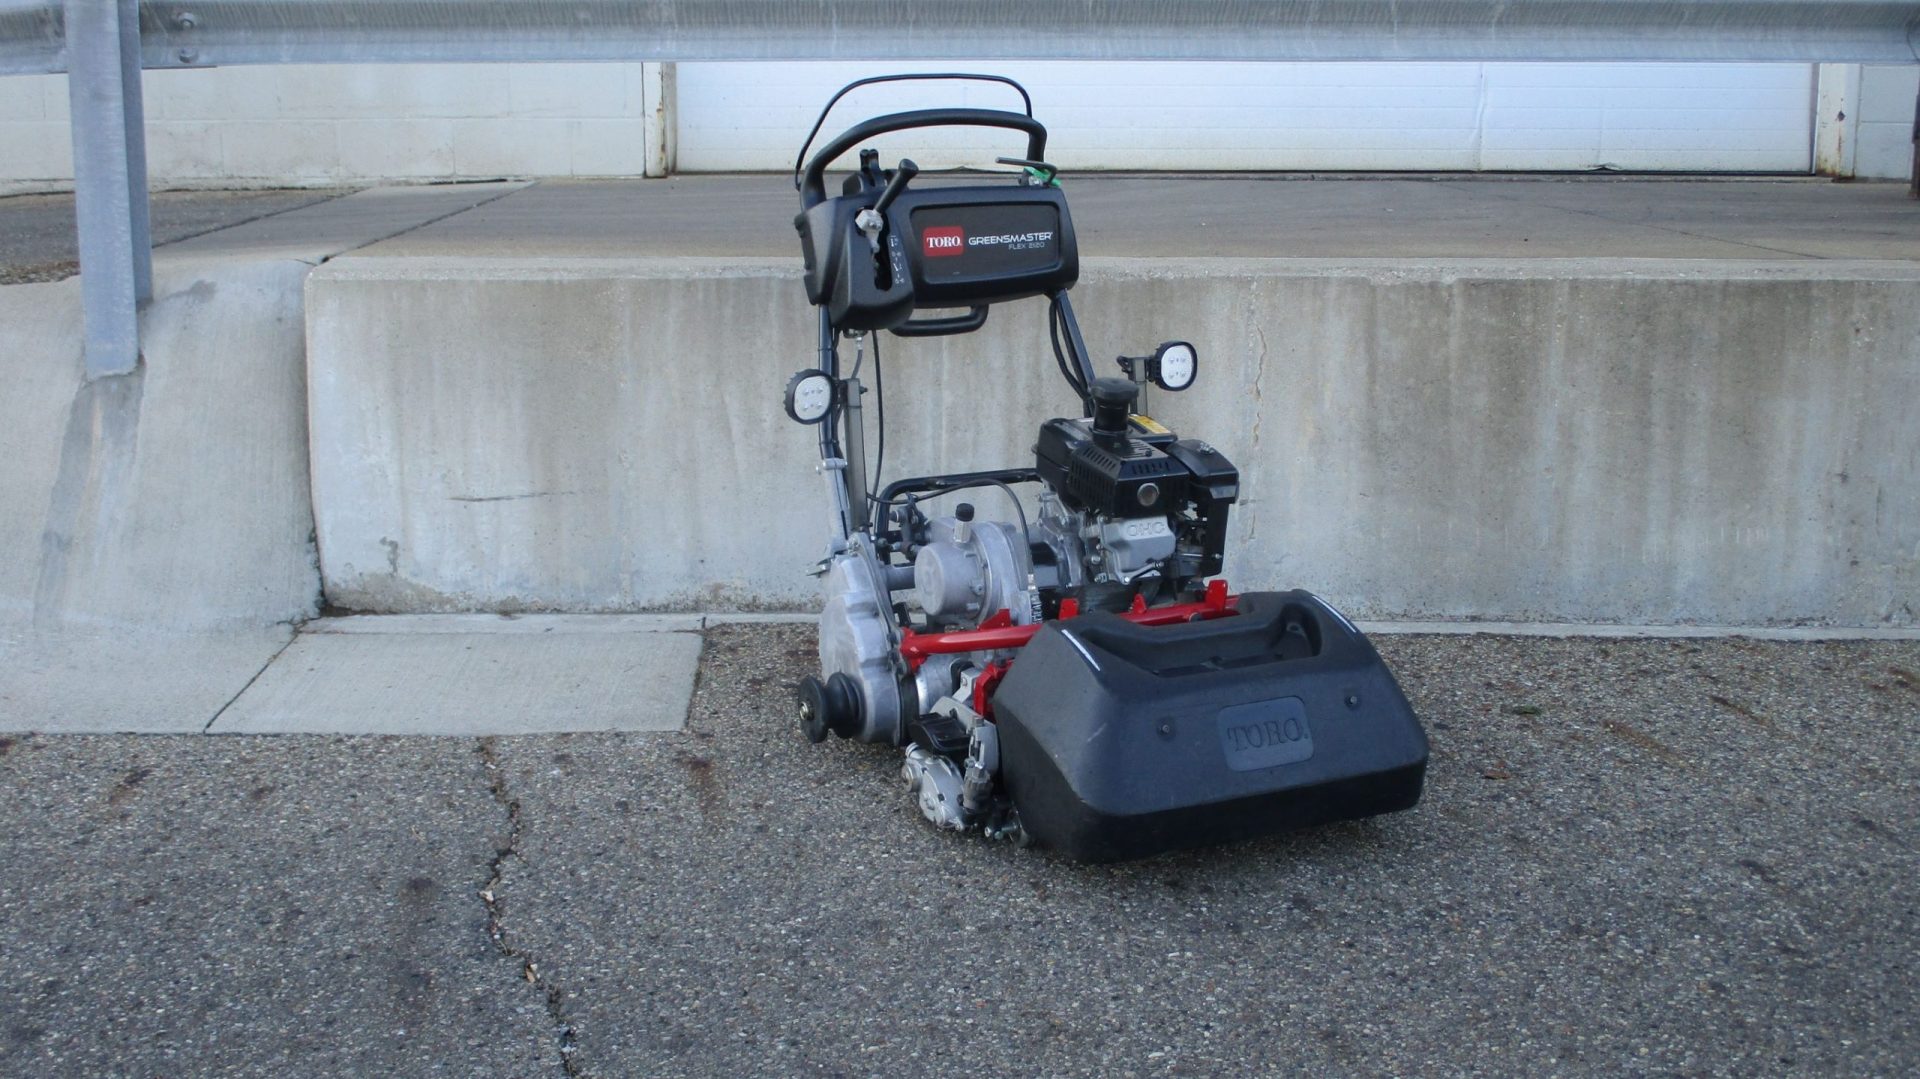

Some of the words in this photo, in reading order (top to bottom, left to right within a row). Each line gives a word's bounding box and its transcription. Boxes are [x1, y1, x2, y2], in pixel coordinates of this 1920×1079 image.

[926, 236, 960, 248] TORO
[968, 232, 1052, 246] GREENSMASTER
[1227, 718, 1304, 752] TORO
